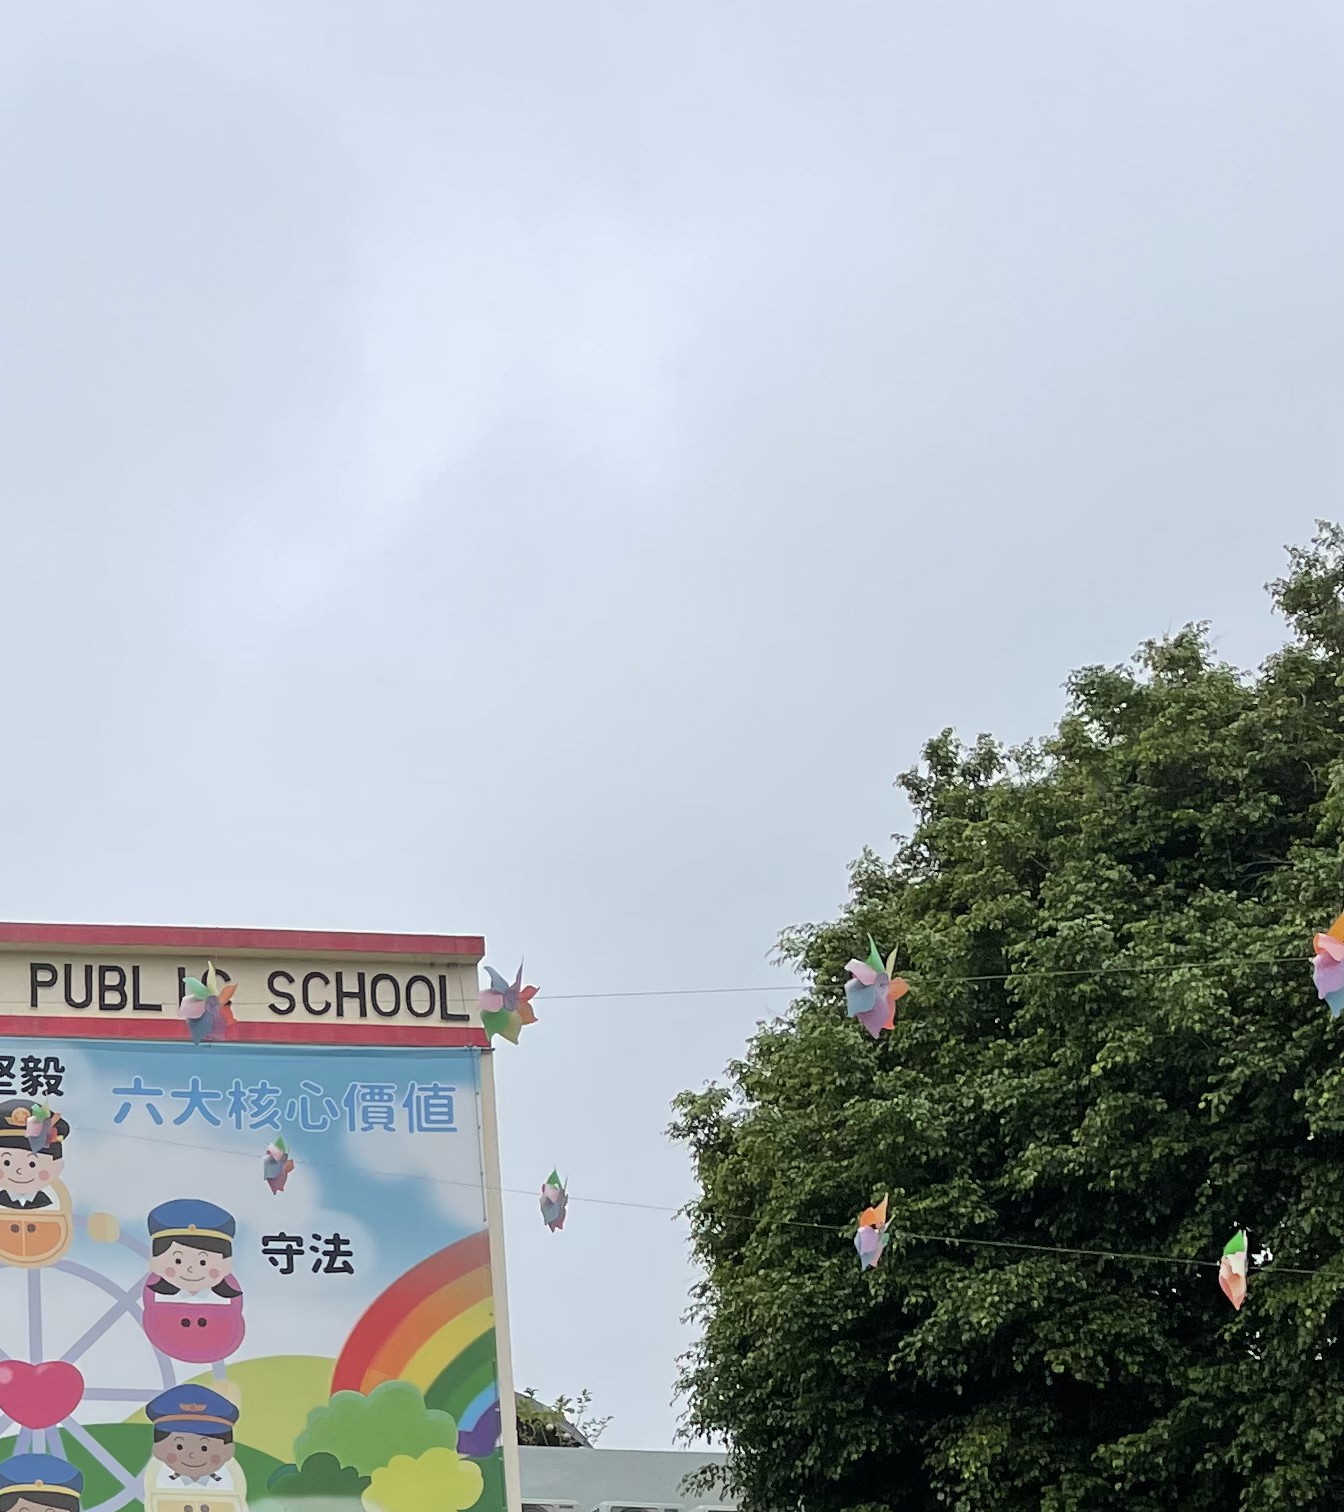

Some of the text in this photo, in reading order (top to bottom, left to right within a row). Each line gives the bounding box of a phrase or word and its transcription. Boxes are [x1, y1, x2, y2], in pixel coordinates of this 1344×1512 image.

[267, 971, 470, 1021] SCHOOL
[111, 1076, 458, 1134] 六大核心價值
[261, 1232, 355, 1275] 守法
